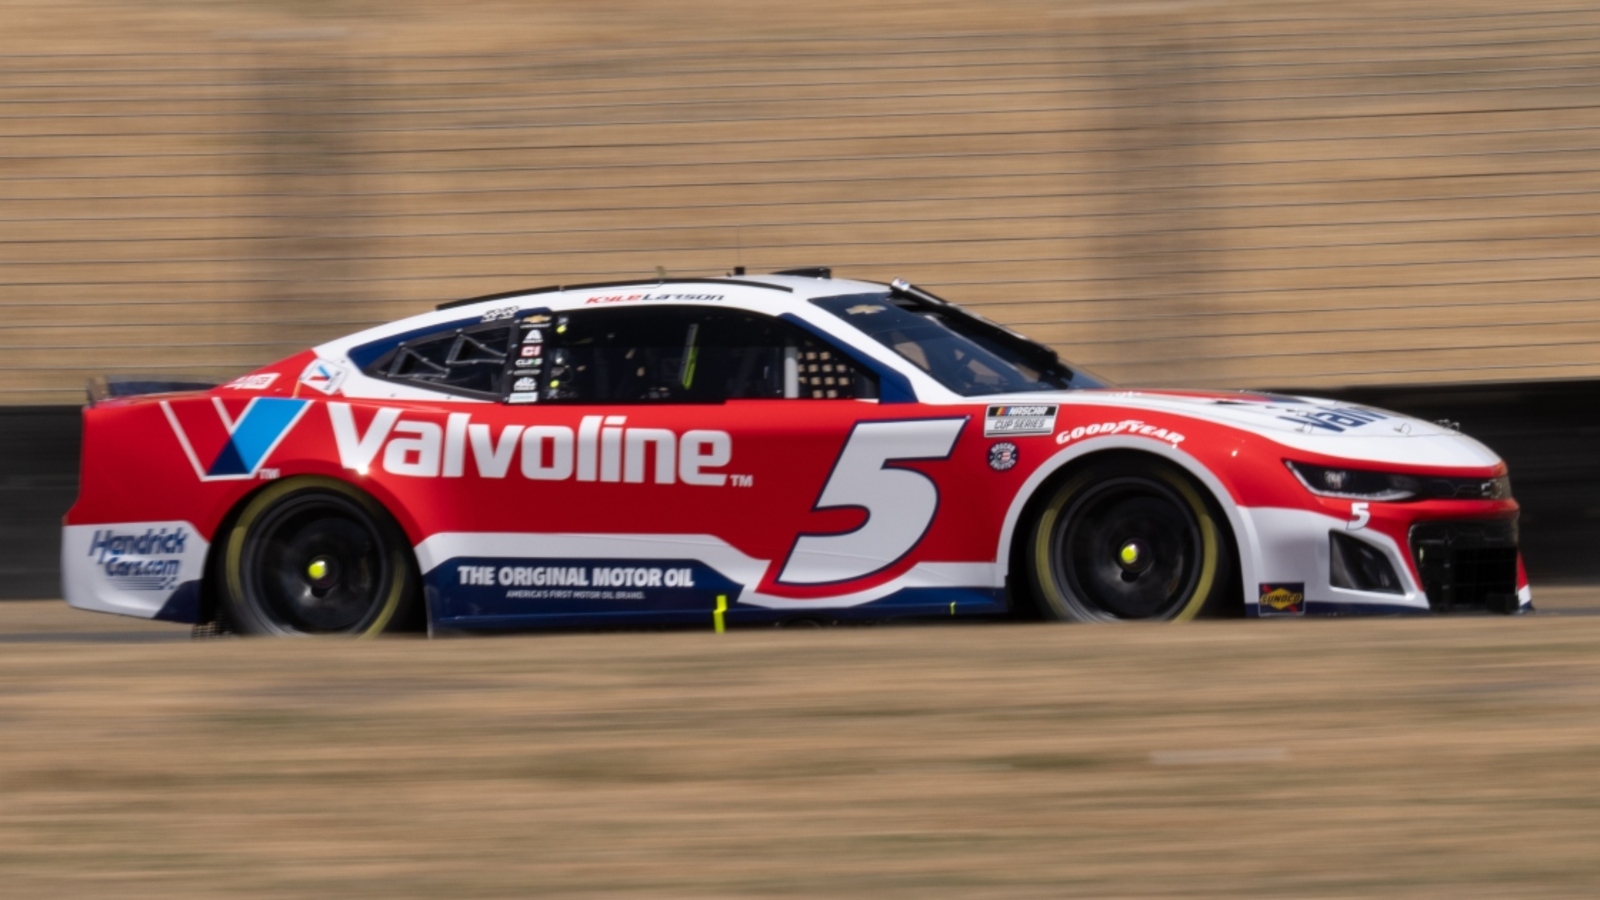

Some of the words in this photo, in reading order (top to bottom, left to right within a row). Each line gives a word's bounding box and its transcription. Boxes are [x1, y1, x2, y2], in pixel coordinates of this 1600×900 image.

[994, 420, 1013, 430] CUP
[1014, 419, 1046, 429] SERIES
[1008, 406, 1048, 416] NASCAR
[326, 401, 732, 487] Valvoline
[1056, 419, 1185, 449] GOODYEAR
[777, 414, 970, 587] 5
[1346, 502, 1371, 531] 5
[87, 527, 189, 565] Hendrick
[457, 565, 496, 586] THE
[498, 565, 589, 587] ORIGINAL
[592, 566, 663, 588] MOTOR
[664, 568, 695, 588] OIL
[505, 590, 549, 599] AMERICA'S
[549, 590, 573, 599] FIRST
[573, 591, 600, 600] MOTOR
[600, 591, 615, 600] OIL
